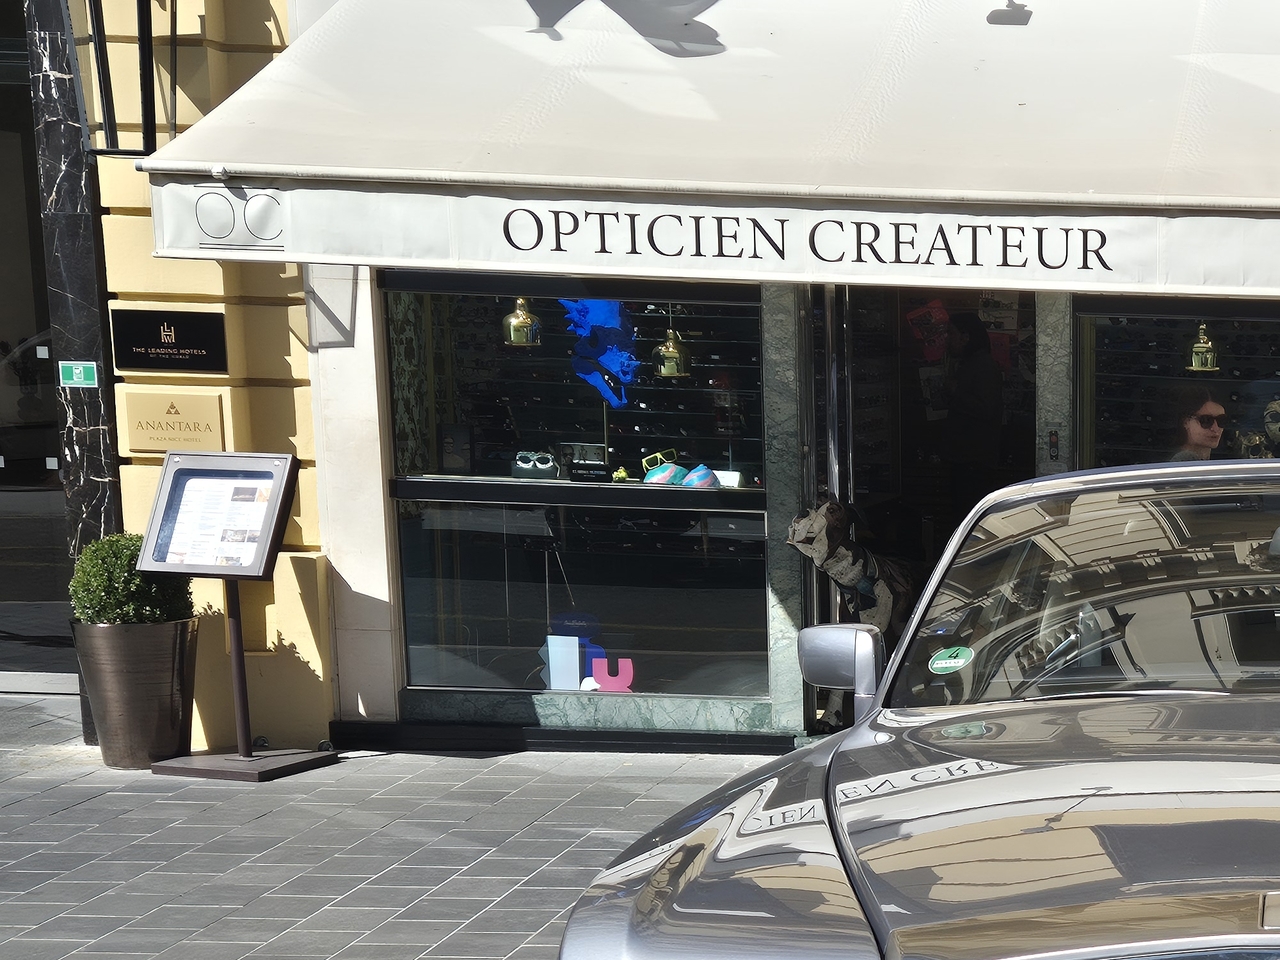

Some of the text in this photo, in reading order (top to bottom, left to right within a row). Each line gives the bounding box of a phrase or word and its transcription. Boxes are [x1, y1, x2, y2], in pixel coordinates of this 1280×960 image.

[502, 208, 1114, 272] OPTICIEN CREATEUR
[147, 347, 178, 355] LEADING
[179, 348, 207, 356] HOTELS
[136, 420, 213, 433] ANANTARA
[947, 647, 961, 660] 4
